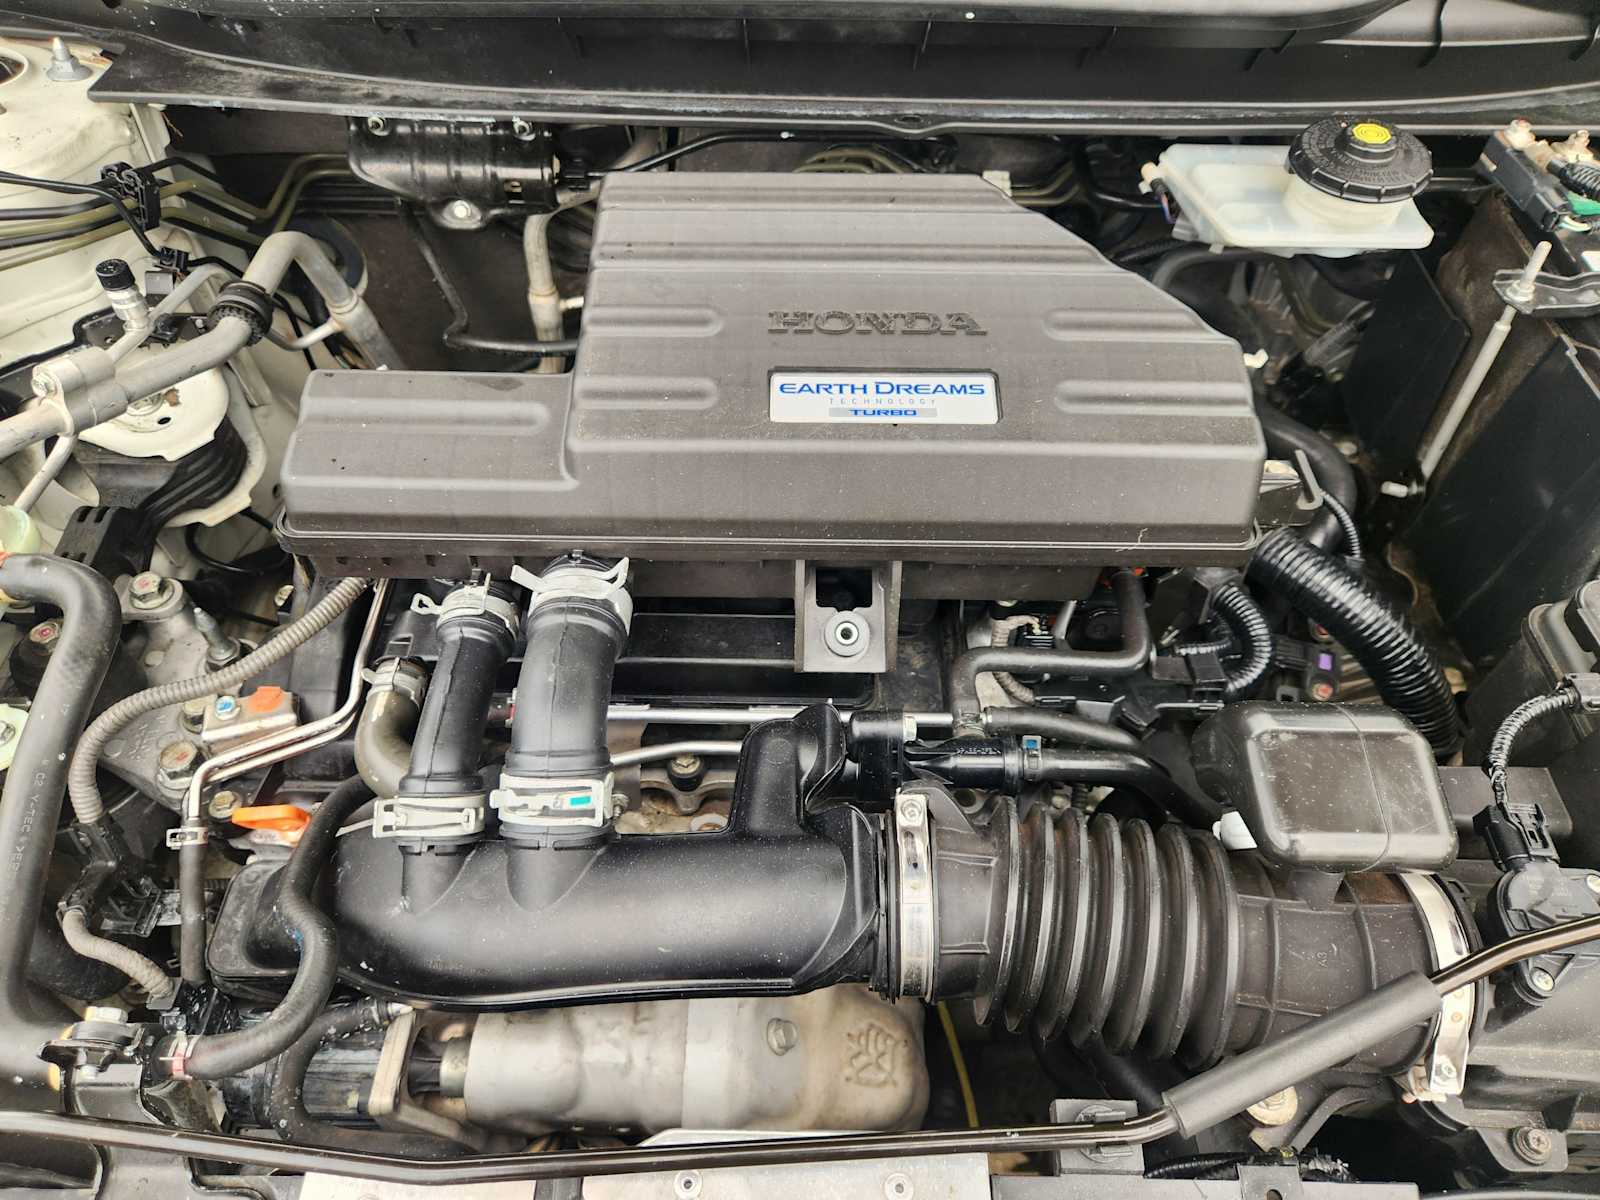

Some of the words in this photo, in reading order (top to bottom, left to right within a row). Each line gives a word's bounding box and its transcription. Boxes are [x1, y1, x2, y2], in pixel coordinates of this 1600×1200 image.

[767, 311, 988, 336] HONDA
[779, 383, 868, 395] EARTH
[874, 382, 985, 395] DREAMS
